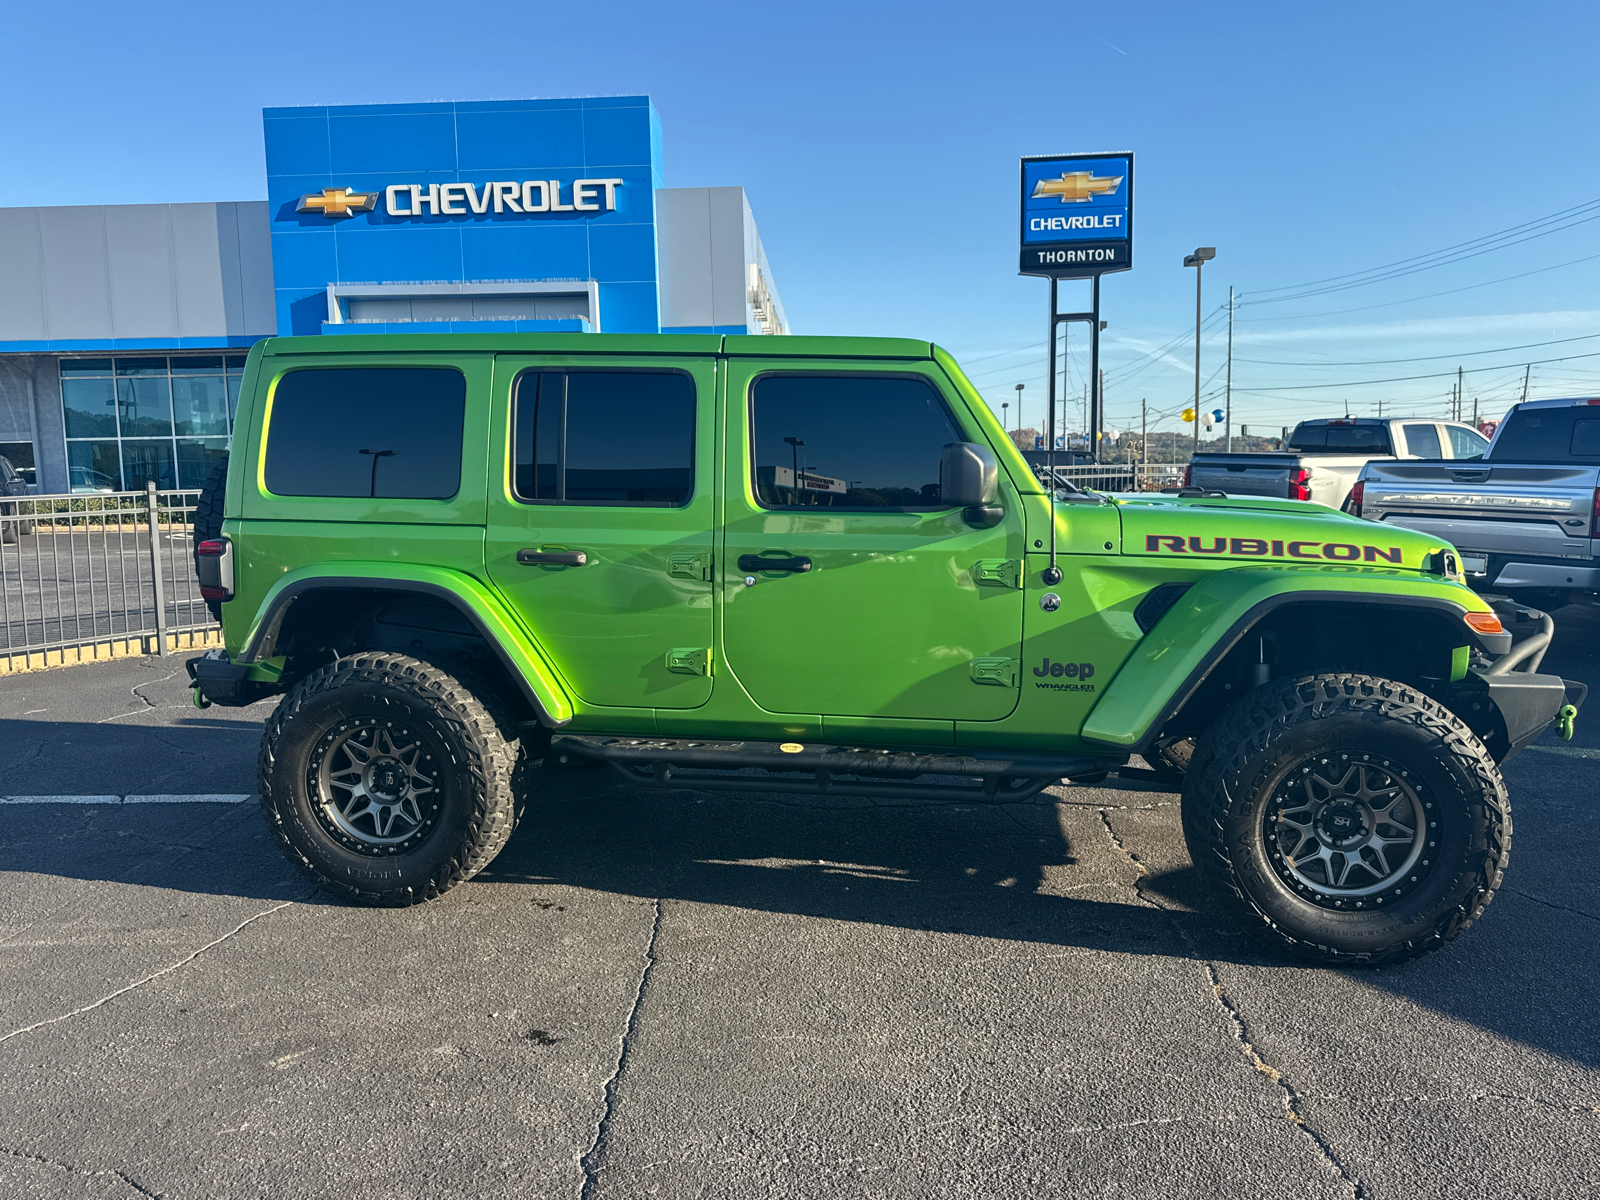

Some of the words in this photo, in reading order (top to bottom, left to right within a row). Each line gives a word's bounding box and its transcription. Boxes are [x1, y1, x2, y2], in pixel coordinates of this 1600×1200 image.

[386, 178, 623, 217] CHEVROLET
[1030, 214, 1122, 231] CHEVROLET
[1038, 248, 1115, 263] THORNTON
[1145, 534, 1402, 564] RUBICON
[1033, 658, 1095, 681] Jeep
[1237, 829, 1266, 888] BAJA
